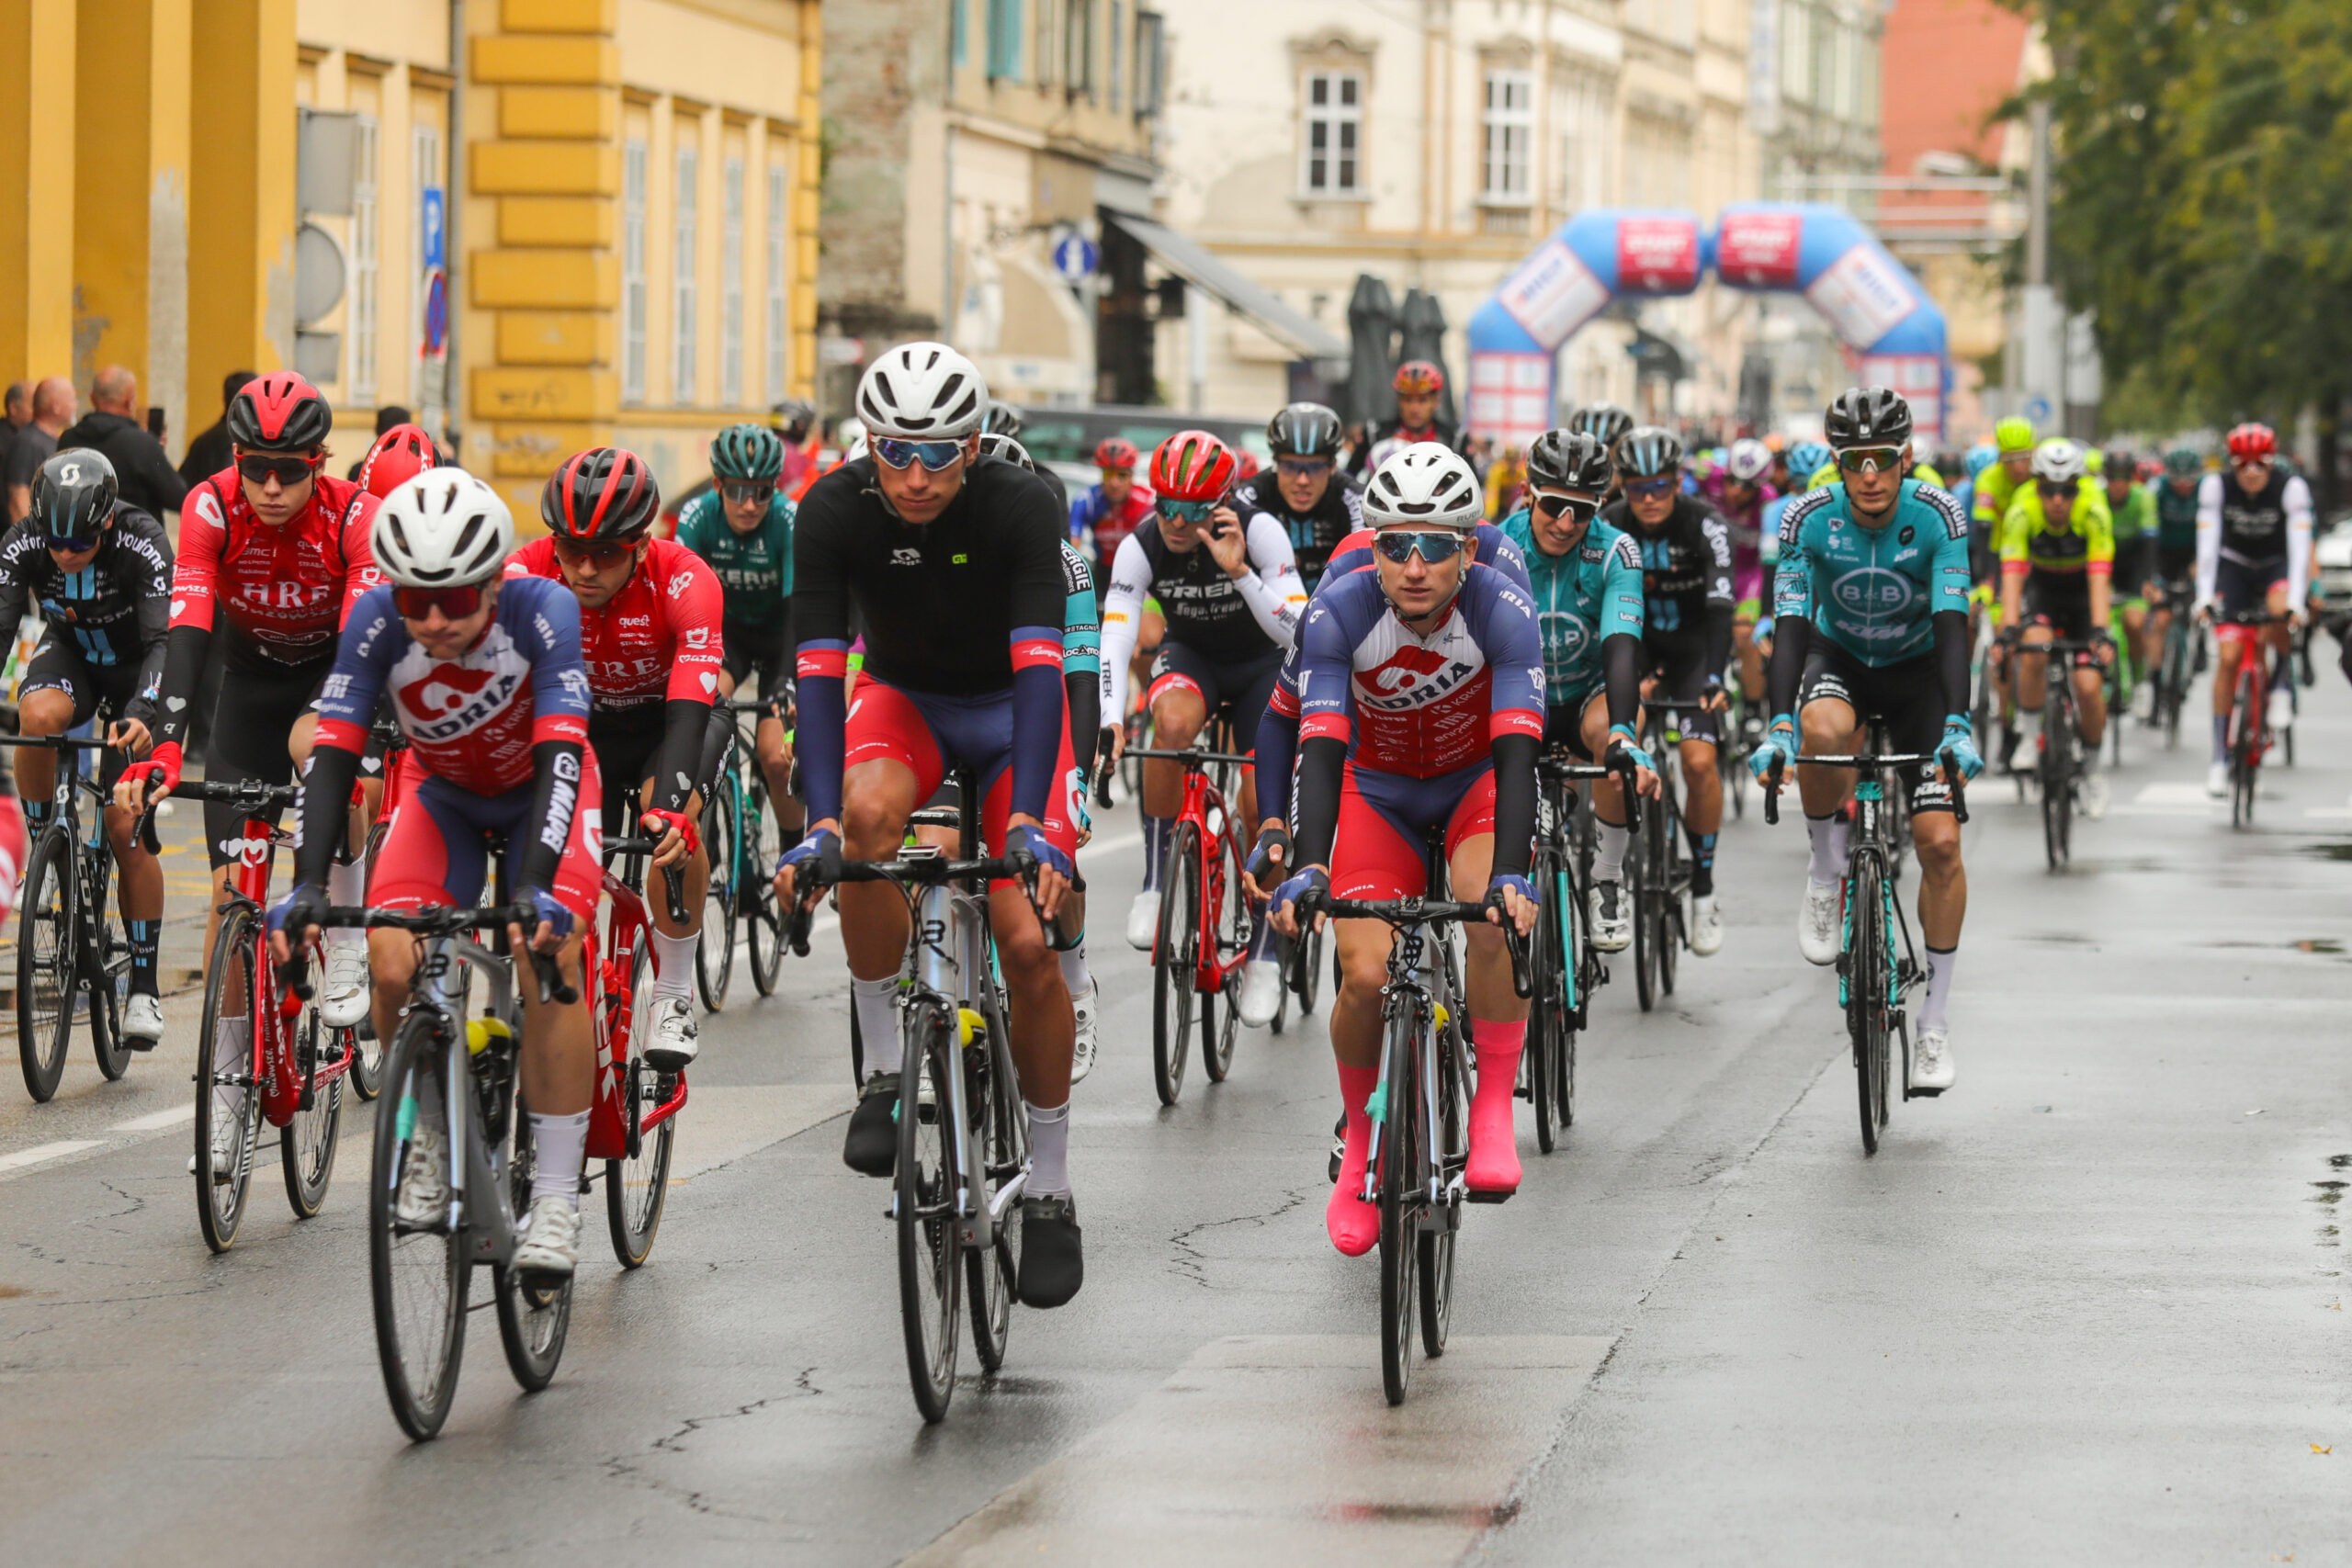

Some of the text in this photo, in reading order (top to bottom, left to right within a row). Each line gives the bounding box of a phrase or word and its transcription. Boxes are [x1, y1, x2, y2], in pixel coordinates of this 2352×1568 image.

[1779, 487, 1831, 540] SYNERGIE
[1917, 483, 1968, 536] SYNERGIE
[116, 529, 166, 571] youfone
[1842, 585, 1860, 601] B
[1881, 585, 1901, 602] B
[618, 615, 650, 628] quest
[1101, 659, 1114, 699] TREK
[1363, 662, 1474, 710] ADRIA
[411, 675, 517, 740] ADRIA
[540, 780, 577, 854] MAPEI
[1340, 884, 1375, 897] ADRIA
